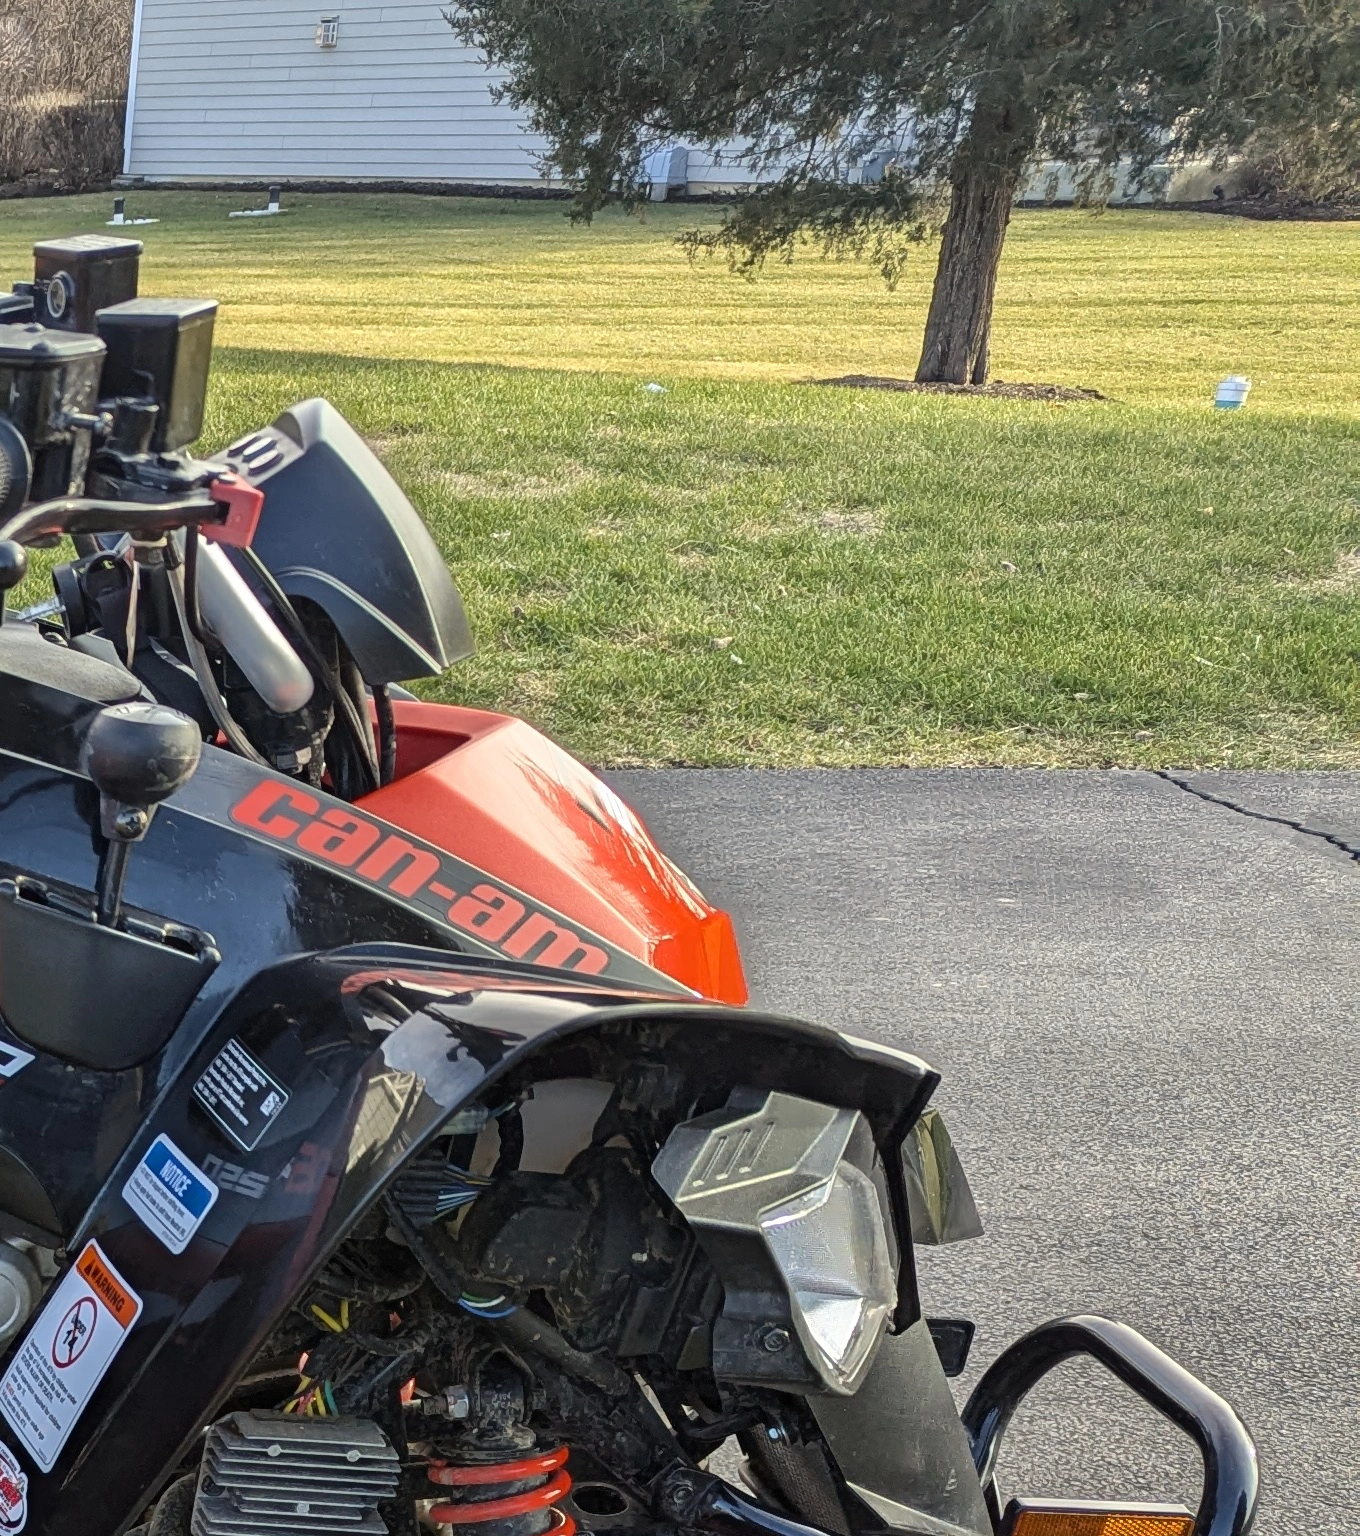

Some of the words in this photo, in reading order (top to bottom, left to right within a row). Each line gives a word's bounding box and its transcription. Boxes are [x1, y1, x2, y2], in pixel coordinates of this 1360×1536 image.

[228, 776, 612, 976] can-am
[158, 1157, 192, 1198] NOTICE
[89, 1264, 126, 1314] WARNING
